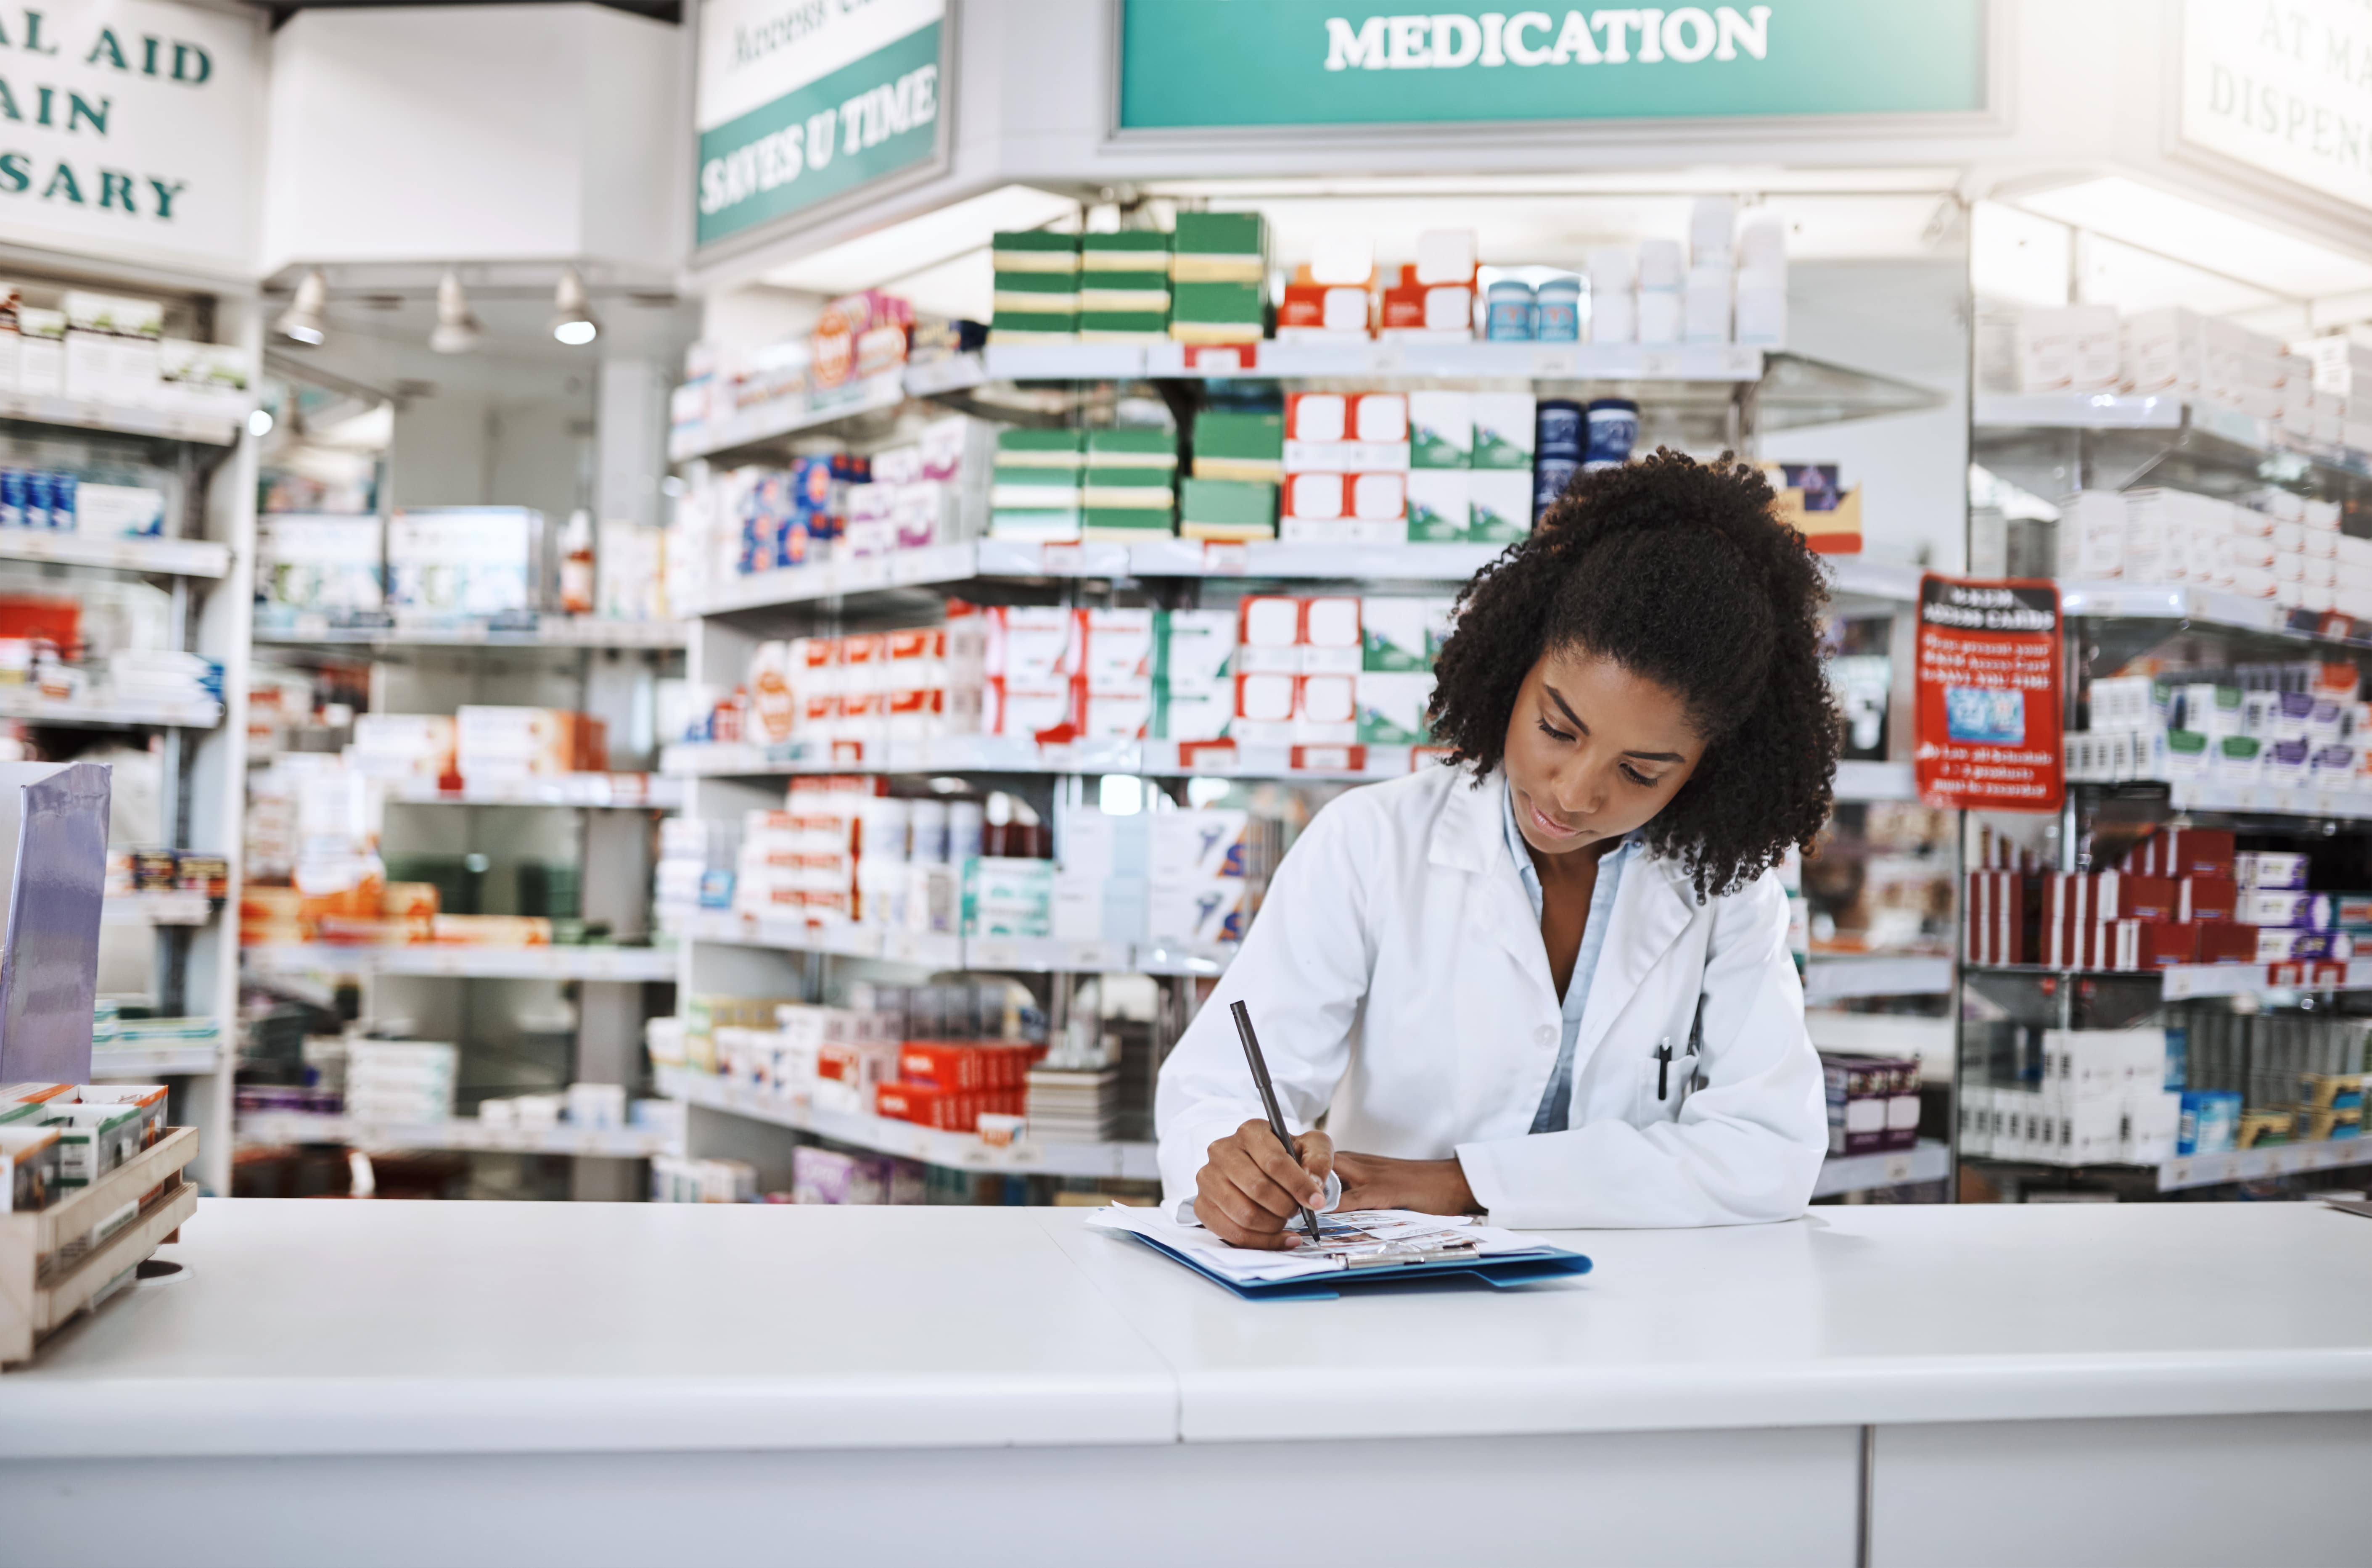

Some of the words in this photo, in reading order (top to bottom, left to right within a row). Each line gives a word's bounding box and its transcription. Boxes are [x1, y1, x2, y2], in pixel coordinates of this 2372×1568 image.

[85, 29, 212, 83] AID
[1324, 5, 1771, 71] MEDICATION
[2256, 1, 2310, 60] AT
[701, 123, 804, 214] SAVES
[806, 108, 837, 170] U
[839, 63, 937, 156] TIME
[2207, 60, 2372, 169] DISPEN
[1986, 610, 2055, 630] CARDS
